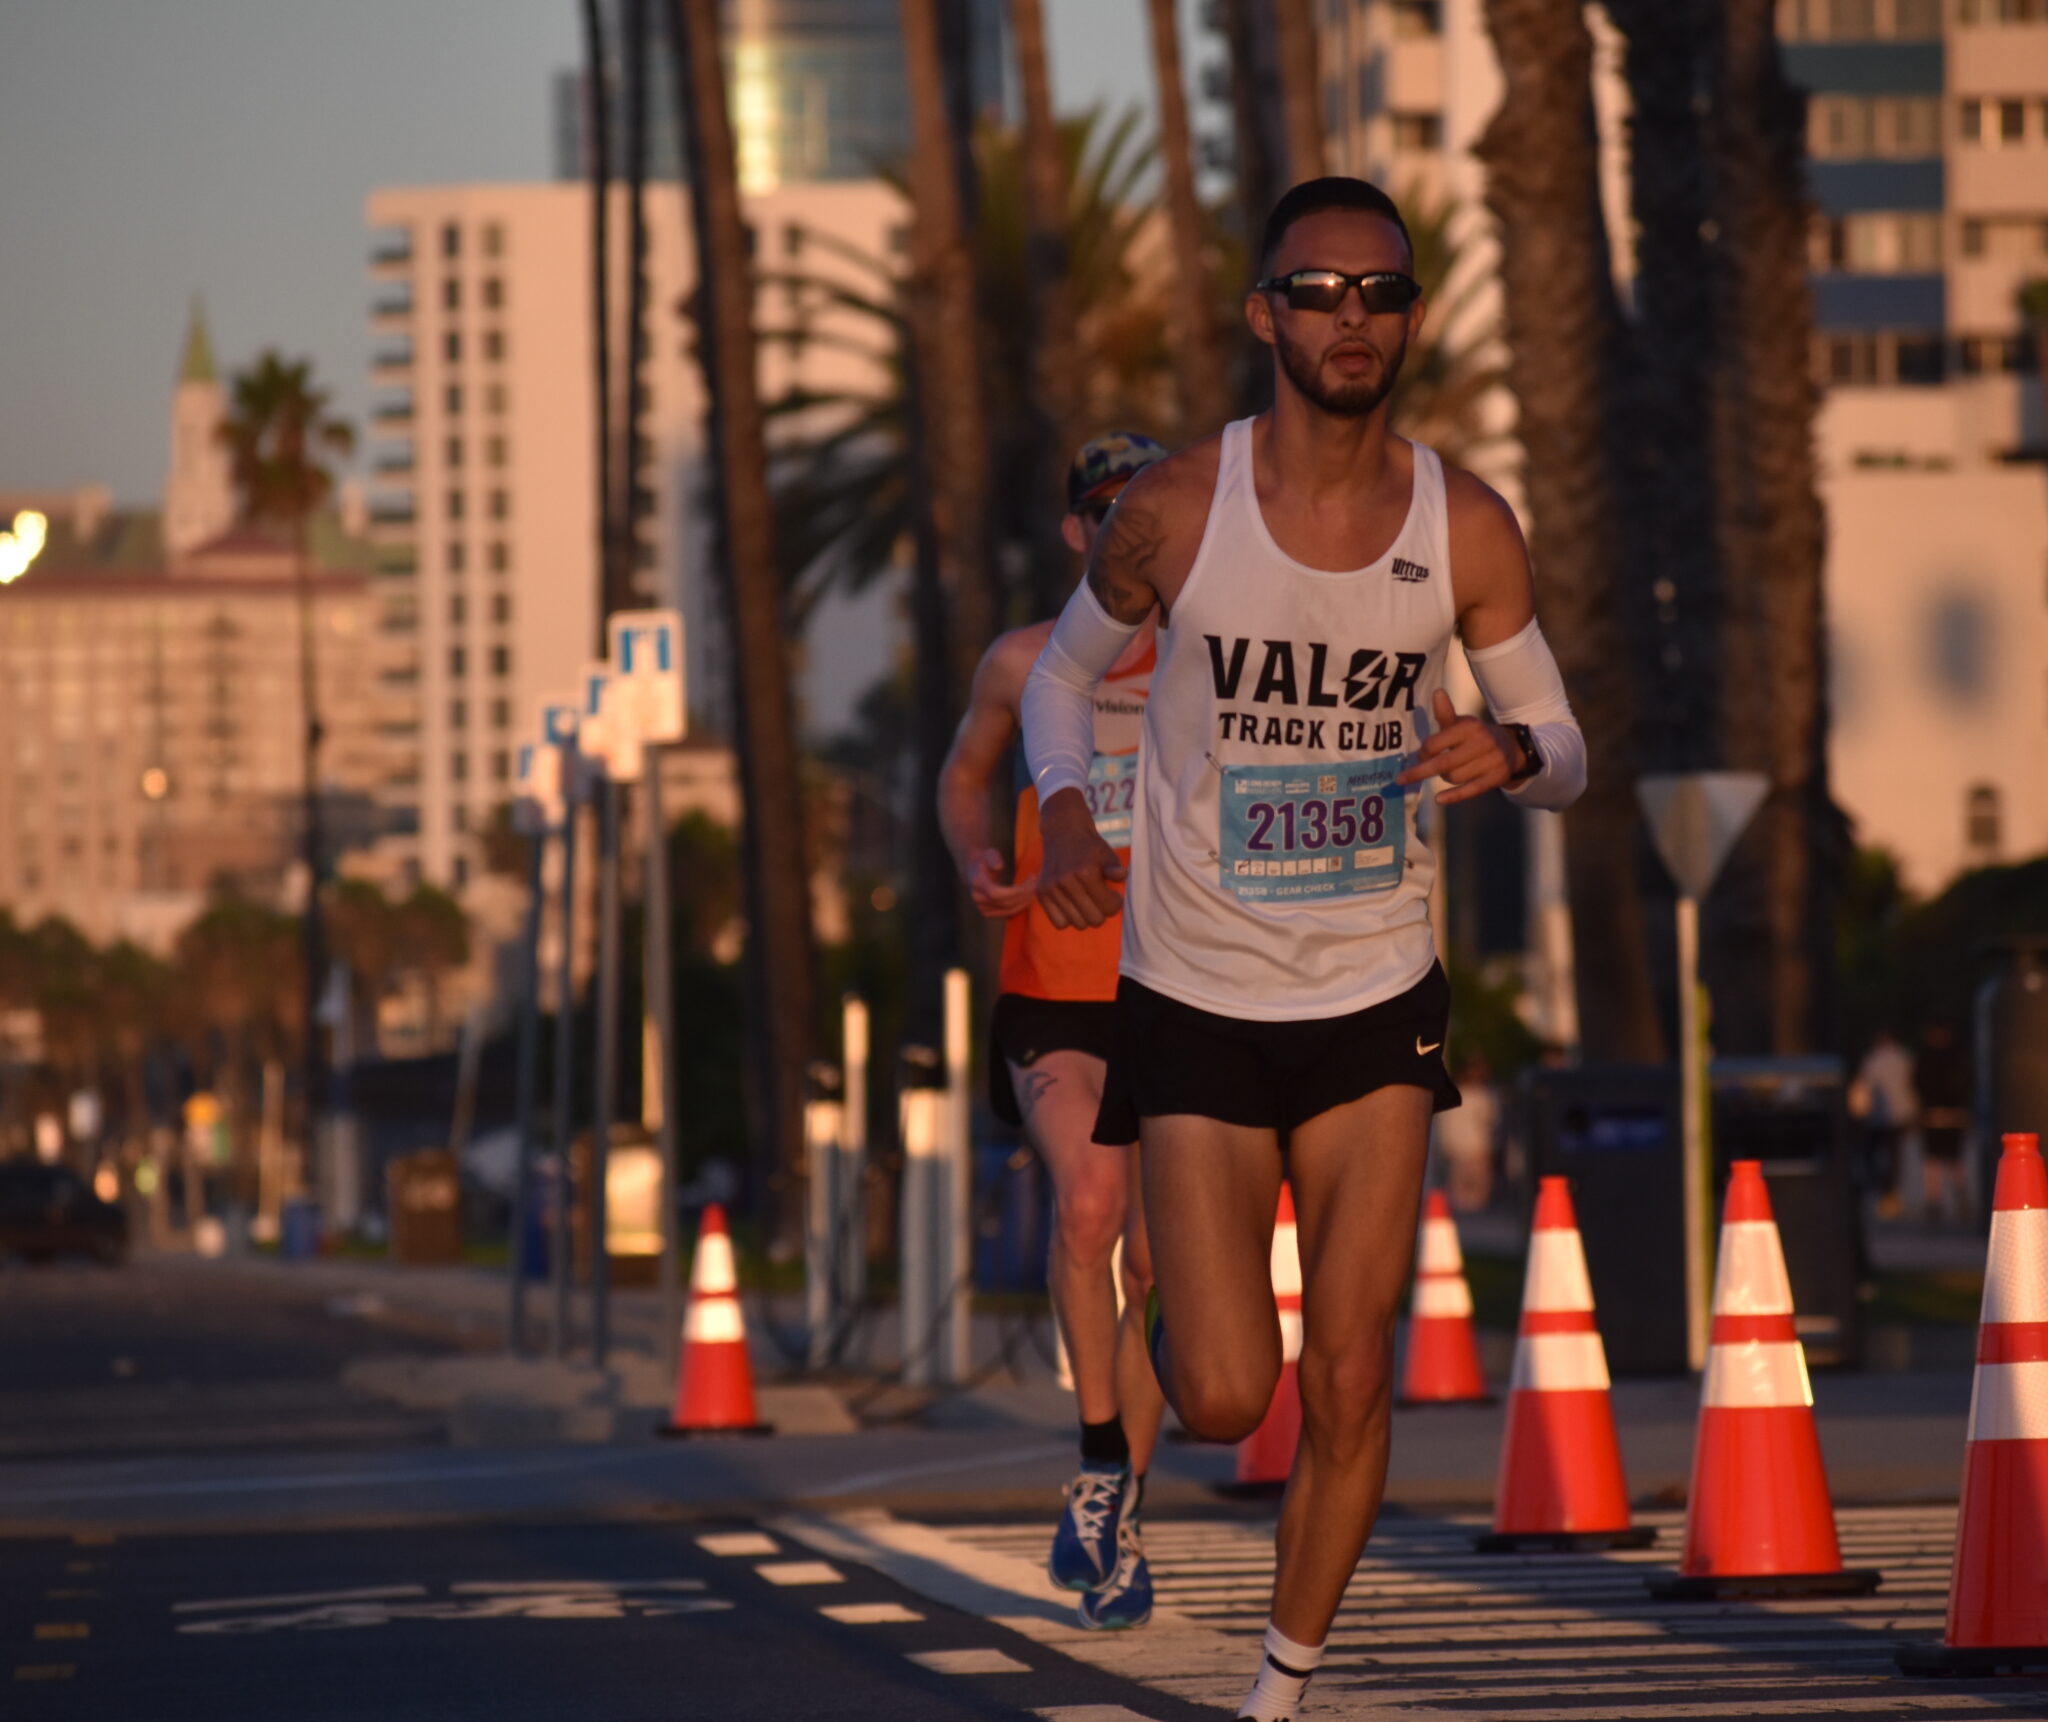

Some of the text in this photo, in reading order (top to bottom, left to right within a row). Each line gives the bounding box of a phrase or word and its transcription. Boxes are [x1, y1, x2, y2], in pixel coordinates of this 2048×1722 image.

[1203, 634, 1427, 712] VALOR
[1219, 711, 1403, 752] TRACK CLUB
[1247, 794, 1385, 851] 21358
[1276, 885, 1303, 896] GEAR
[1304, 883, 1336, 894] CHECK
